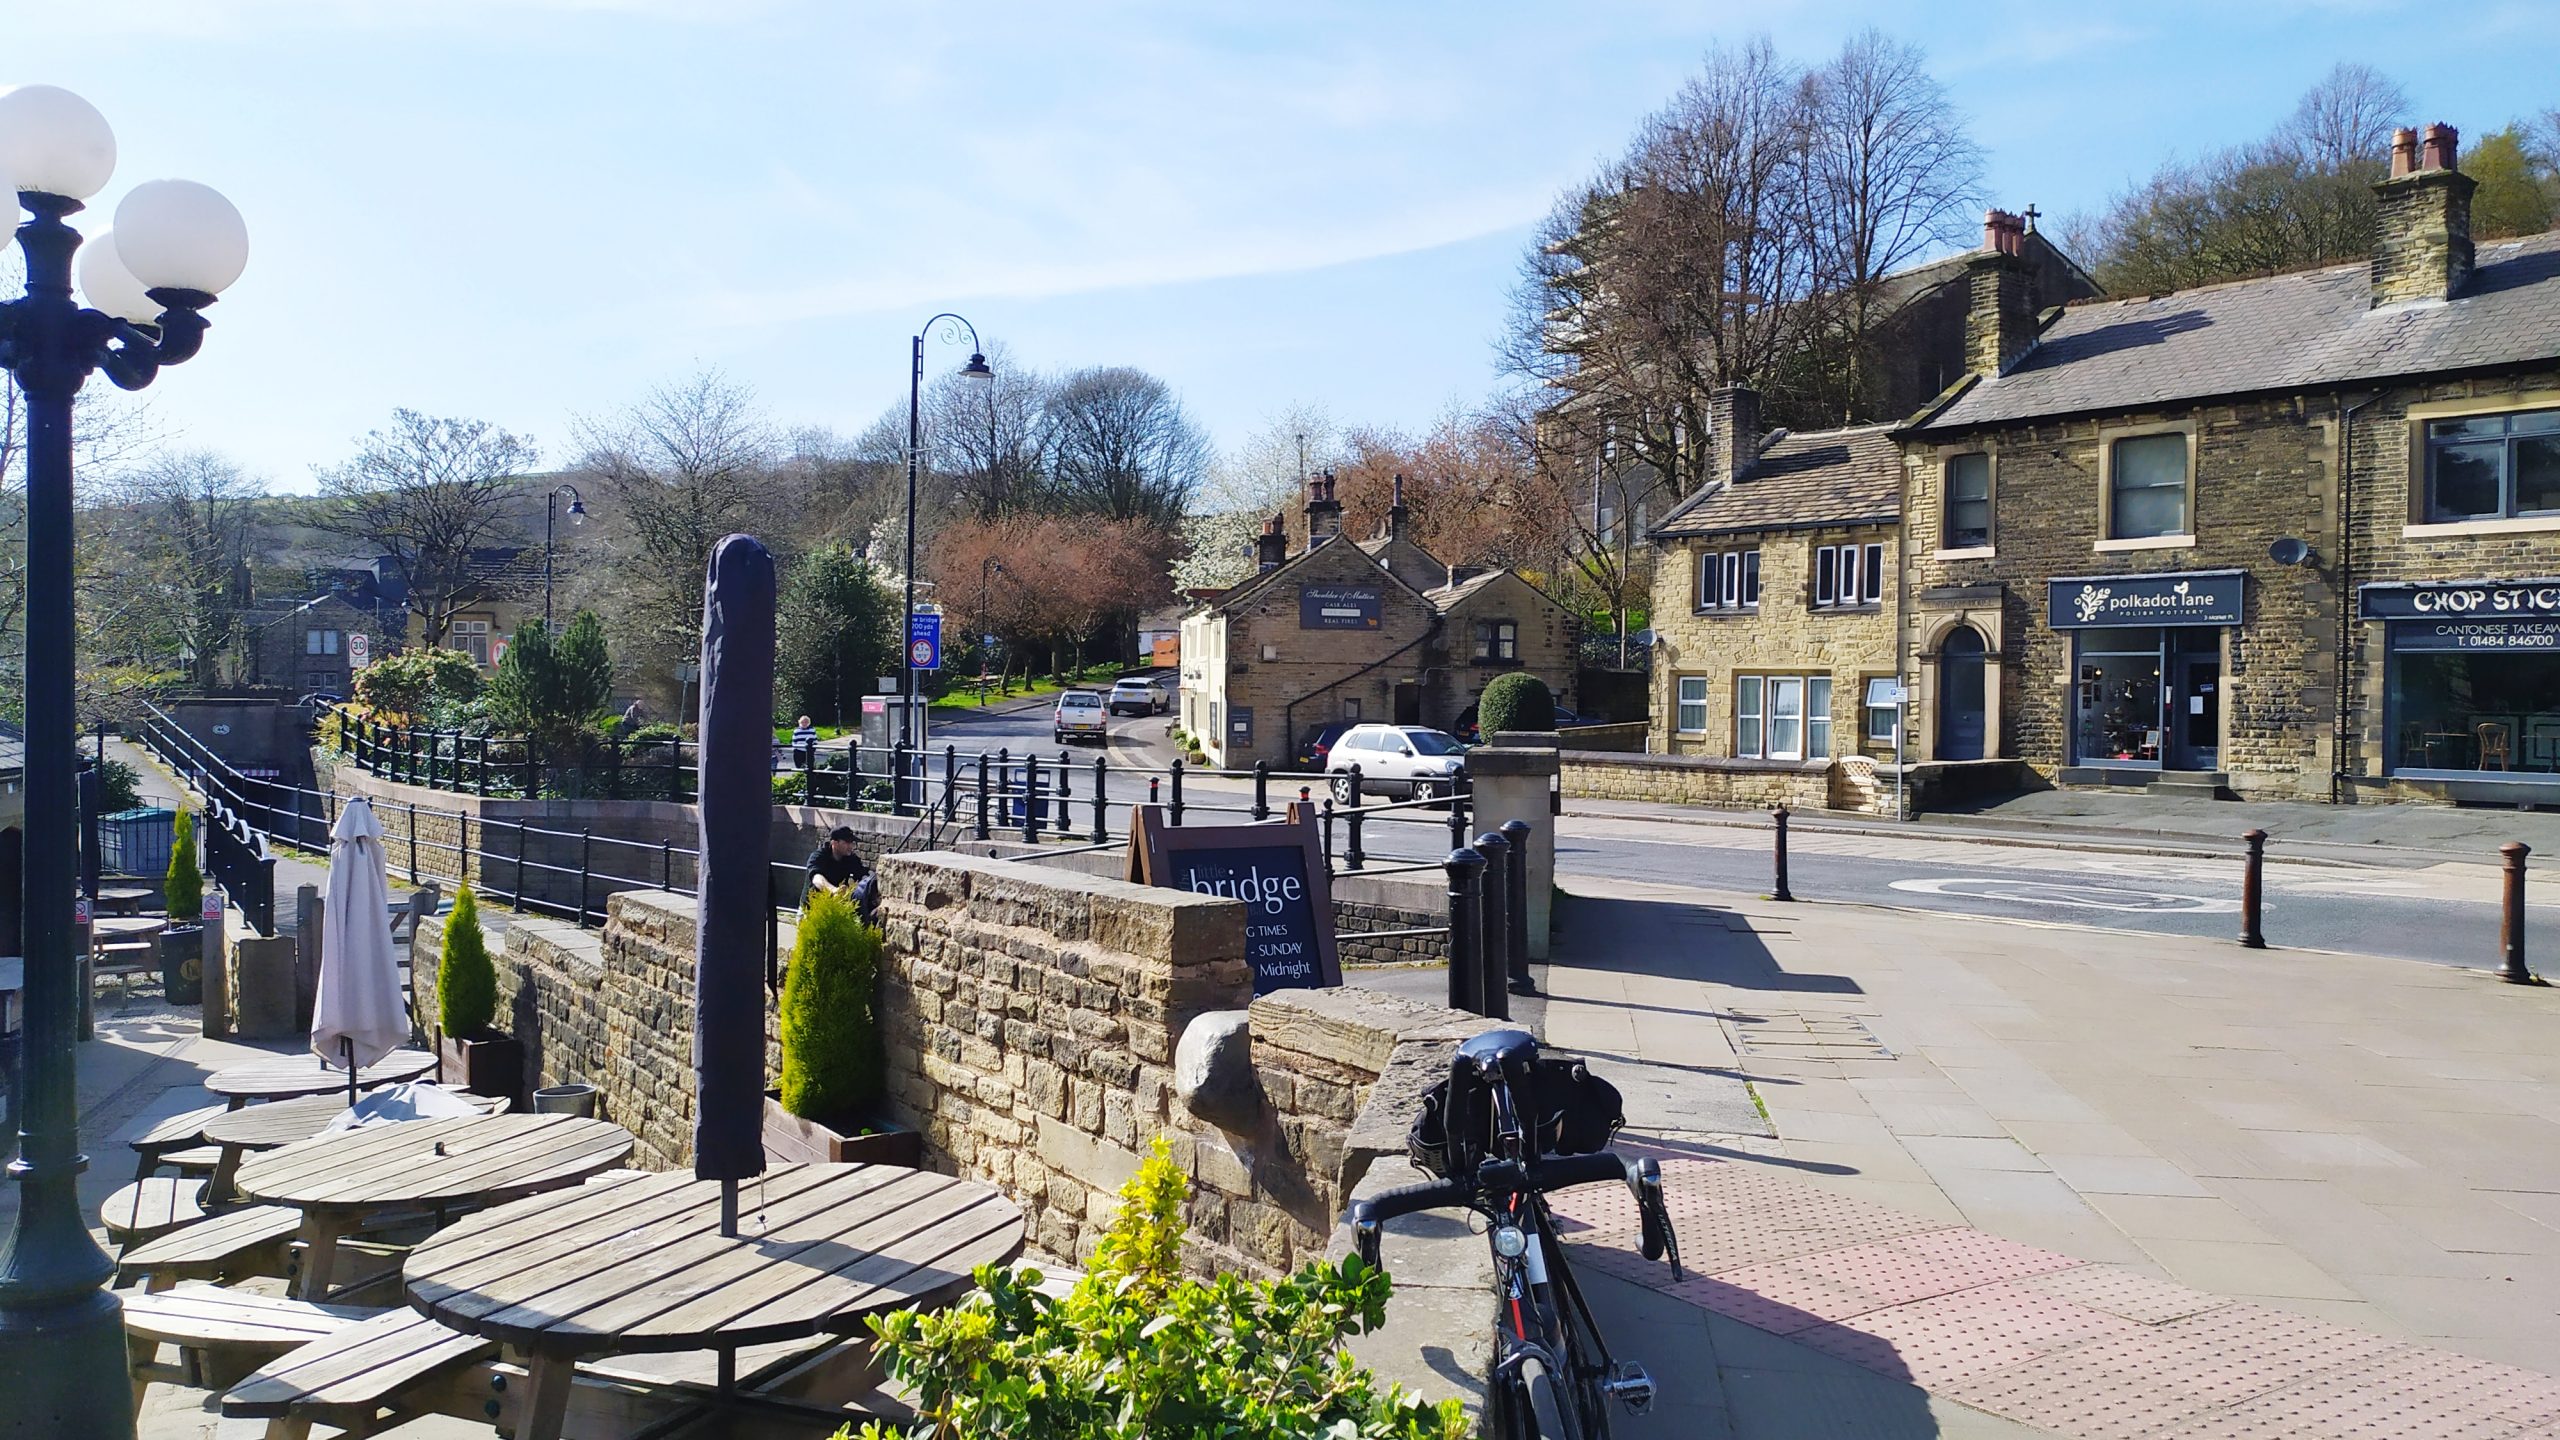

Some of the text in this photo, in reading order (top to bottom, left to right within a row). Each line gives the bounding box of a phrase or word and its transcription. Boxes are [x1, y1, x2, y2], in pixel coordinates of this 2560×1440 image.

[1306, 589, 1375, 602] Shoulder of Mutton
[2110, 593, 2214, 611] polkadot lane
[2413, 588, 2560, 612] CHOP STIC
[2435, 625, 2508, 635] CANTONESE
[353, 641, 365, 650] 30
[2457, 635, 2554, 646] T. 01484 846700
[1189, 866, 1301, 914] bridge
[1257, 924, 1288, 937] TIMES
[1258, 942, 1303, 957] SUNDAY
[1259, 959, 1312, 979] Midnight
